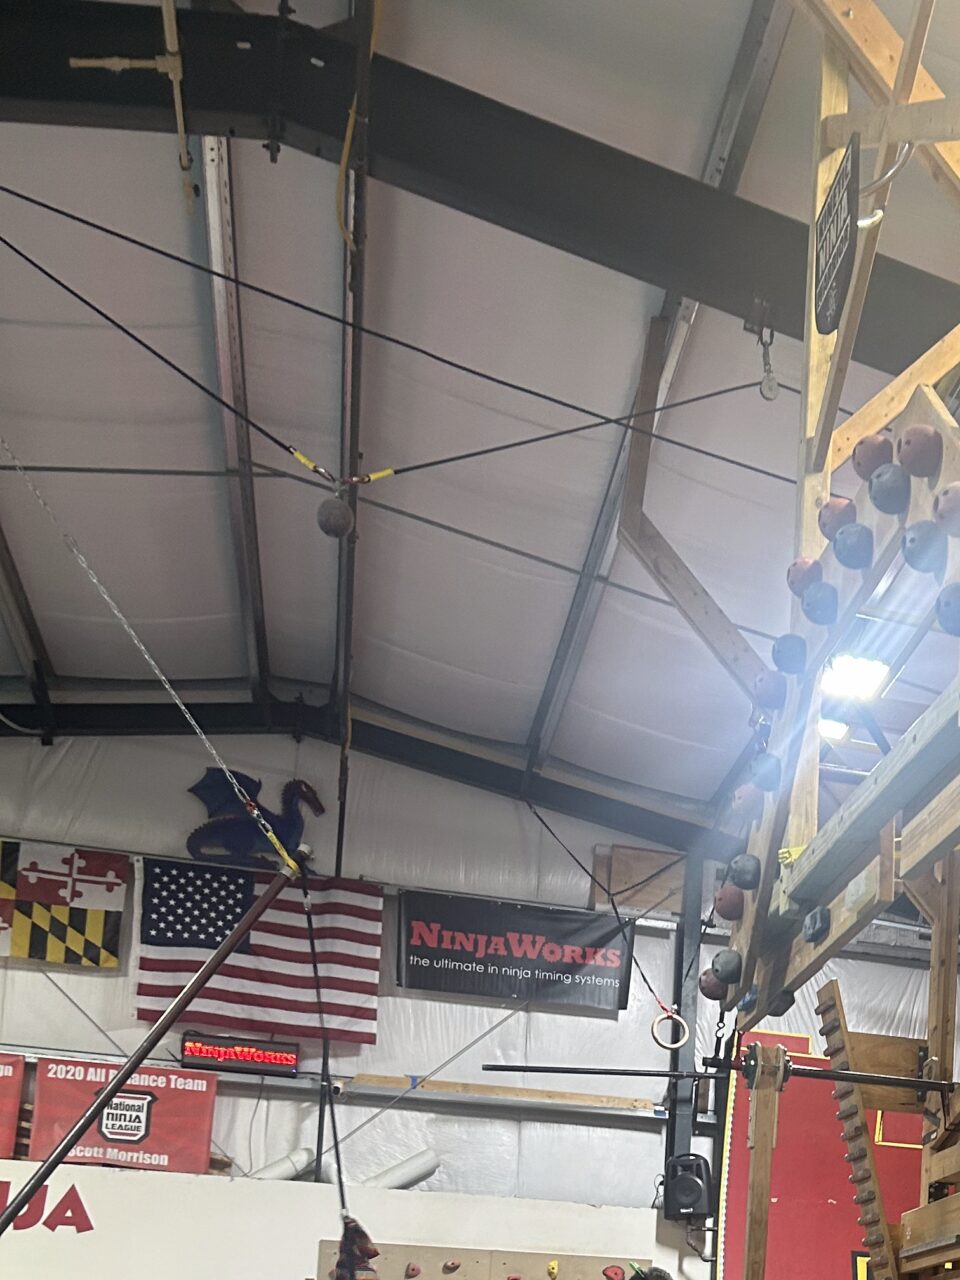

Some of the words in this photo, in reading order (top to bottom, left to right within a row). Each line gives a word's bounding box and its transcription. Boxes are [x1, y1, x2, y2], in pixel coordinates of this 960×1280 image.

[409, 920, 622, 968] NINJAWORKS
[409, 955, 430, 967] the
[433, 957, 484, 973] ultimate
[487, 963, 499, 975] in
[502, 966, 531, 980] ninja
[535, 969, 572, 984] timing
[574, 974, 620, 988] systems
[47, 1063, 84, 1080] 2020
[86, 1066, 106, 1083] All
[169, 1074, 207, 1092] Team
[106, 1100, 145, 1113] National
[105, 1123, 142, 1132] LEAGUE
[106, 1112, 142, 1124] NINJA
[68, 1145, 104, 1158] Scott
[106, 1147, 169, 1166] Morrison
